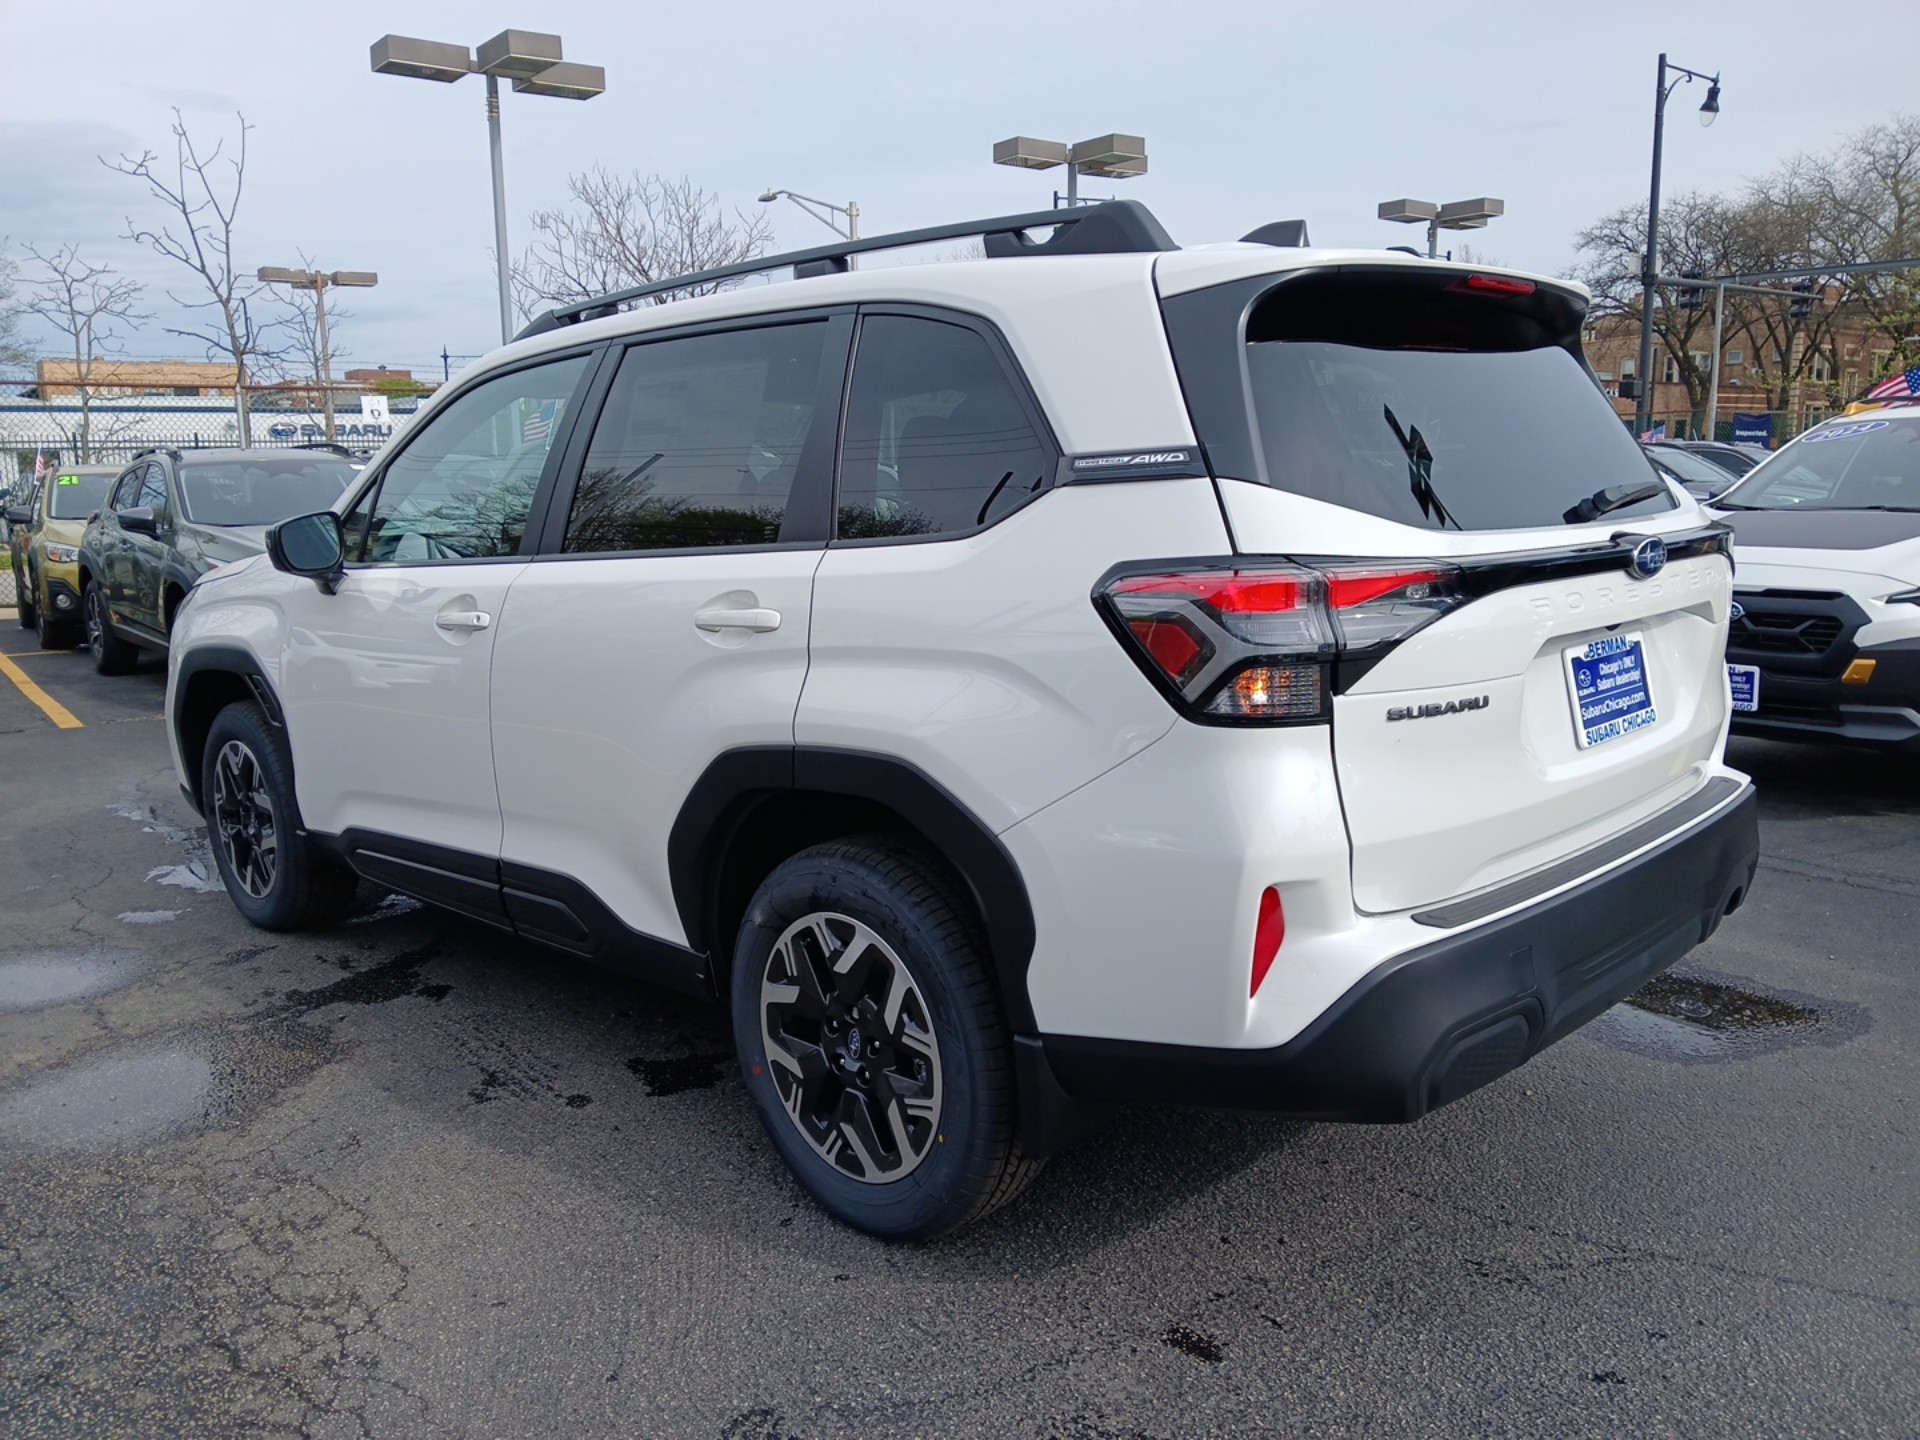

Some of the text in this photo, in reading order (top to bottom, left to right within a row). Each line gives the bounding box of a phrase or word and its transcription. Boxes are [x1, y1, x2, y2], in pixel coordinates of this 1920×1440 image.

[1129, 452, 1184, 464] AWD
[1529, 566, 1719, 620] FORESTER
[1588, 635, 1627, 658] BERMAN
[1387, 695, 1490, 721] SUBARU
[1582, 692, 1646, 720] SubaruChicago.com
[1586, 708, 1657, 745] SUBARU CHICAGO
